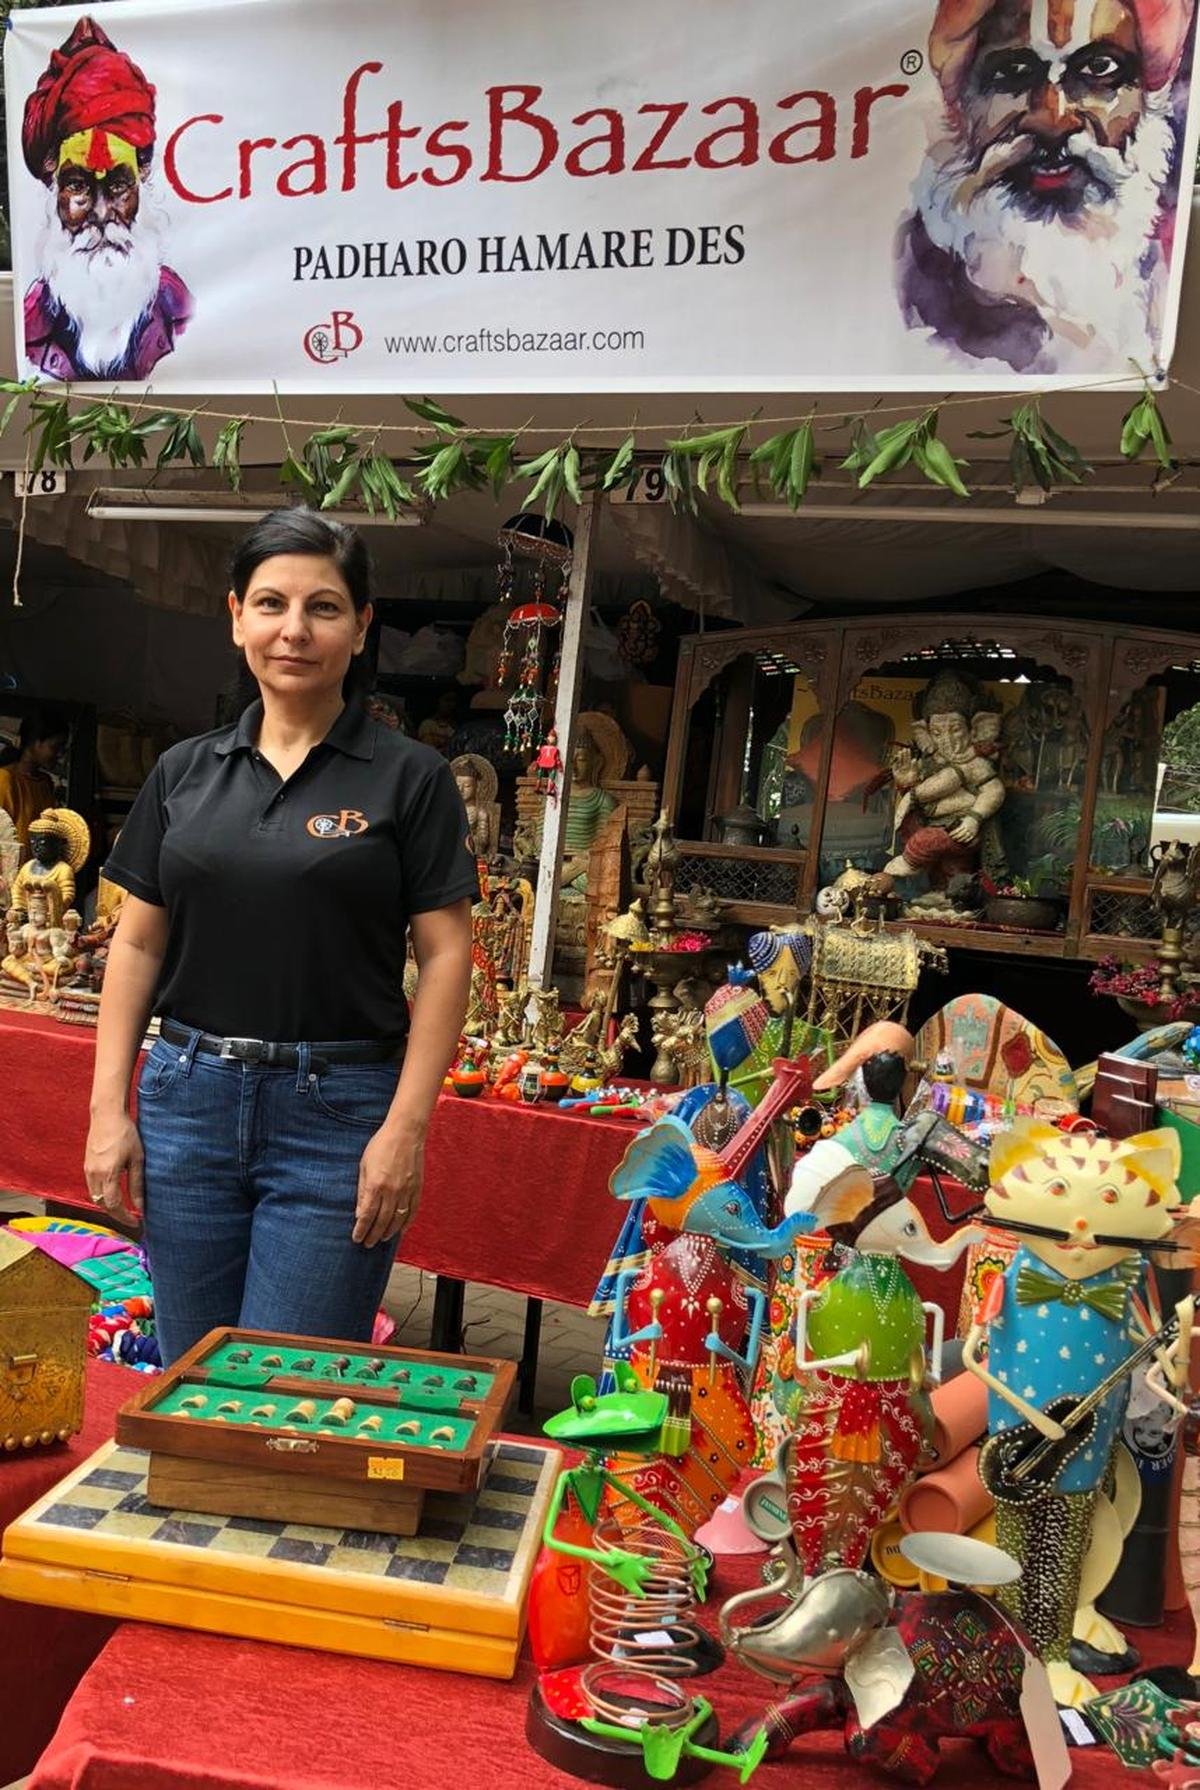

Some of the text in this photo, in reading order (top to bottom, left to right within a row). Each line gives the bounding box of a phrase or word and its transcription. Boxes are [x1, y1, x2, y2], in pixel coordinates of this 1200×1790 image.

[164, 62, 910, 204] CraftsBazaar
[293, 224, 746, 281] PADHARO HAMARE DES
[384, 327, 645, 354] www.craftsbazaar.com
[24, 470, 57, 494] 78
[625, 468, 666, 501] 79
